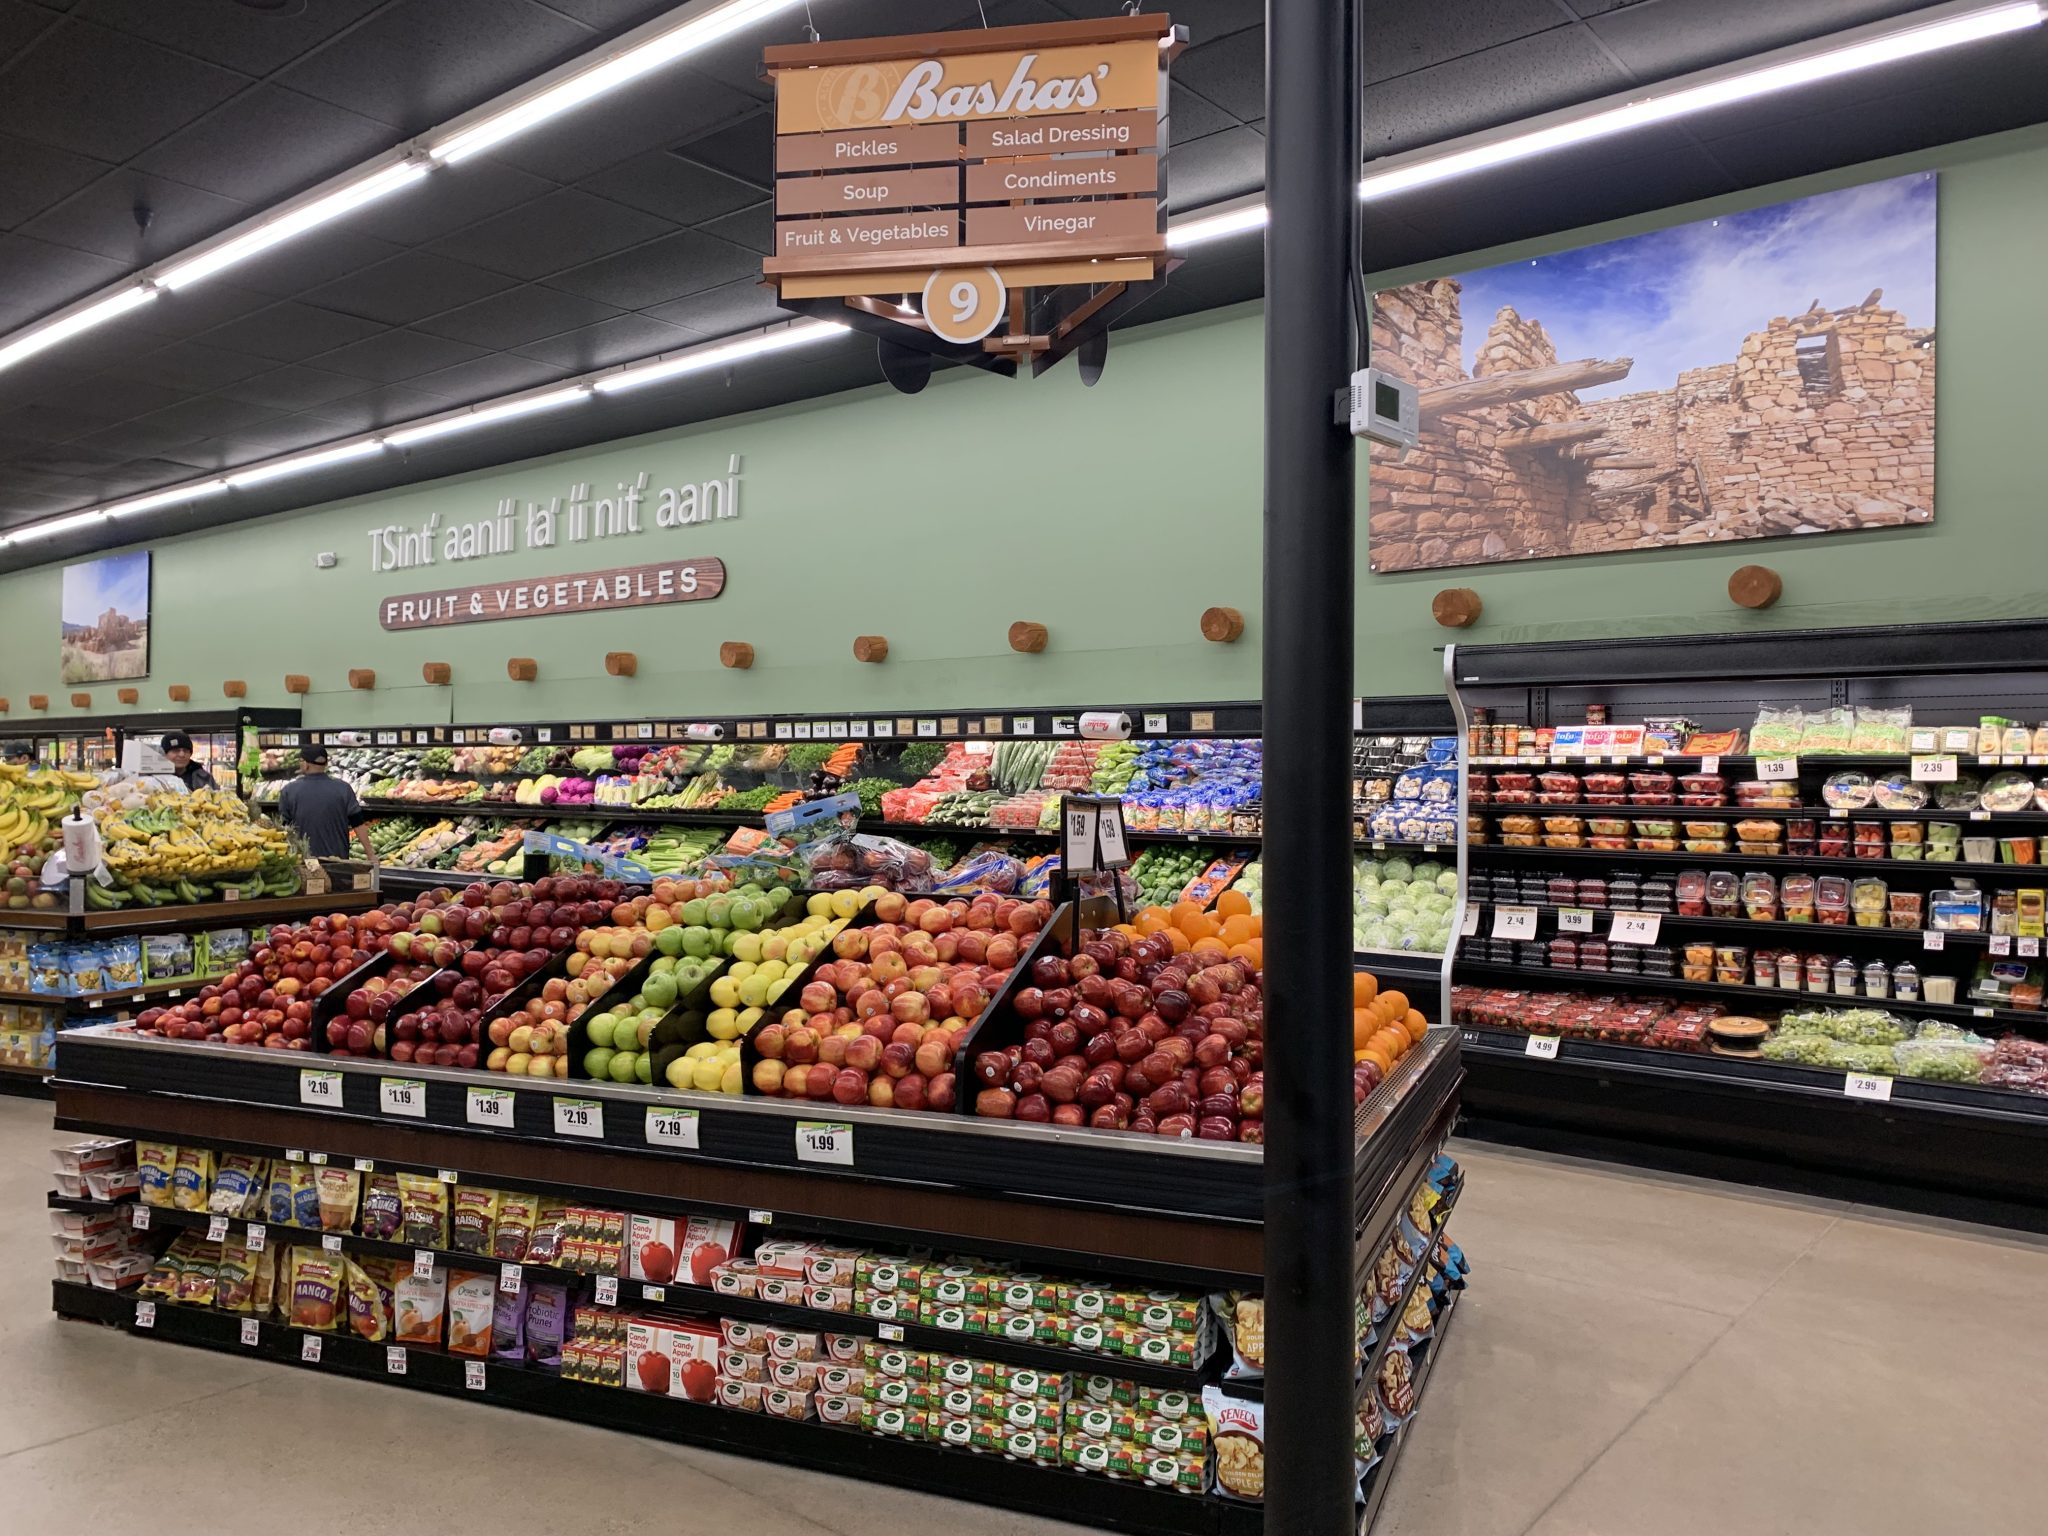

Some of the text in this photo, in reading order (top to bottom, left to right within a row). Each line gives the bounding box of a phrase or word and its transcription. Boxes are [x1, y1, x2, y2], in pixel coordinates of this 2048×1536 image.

[881, 54, 1110, 121] Bashas'
[992, 124, 1130, 148] Salad Dressing
[835, 140, 898, 158] Pickles
[1004, 168, 1117, 190] Condiments
[843, 184, 889, 202] Soup
[1024, 214, 1096, 235] Vinegar
[785, 222, 949, 247] Fruit & Vegetables
[949, 281, 978, 323] 9
[387, 567, 699, 624] FRUIT & VEGETABLES
[1764, 763, 1784, 774] $1.39
[1921, 763, 1943, 773] $2.39
[1564, 915, 1582, 925] $3.99
[1535, 1041, 1553, 1052] $4.99
[308, 1080, 329, 1095] $2.19
[1855, 1080, 1877, 1091] $2.99
[389, 1089, 411, 1104] $1.19
[476, 1099, 499, 1115] $1.39
[564, 1109, 587, 1125] $2.19
[655, 1119, 681, 1136] $2.19
[806, 1134, 834, 1151] $1.99
[366, 1200, 398, 1212] PRUNES
[405, 1212, 434, 1225] RAISINS
[455, 1216, 484, 1229] RAISINS
[632, 1224, 652, 1235] Candy
[689, 1224, 710, 1235] Candy
[632, 1231, 650, 1241] Apple
[686, 1233, 706, 1242] Apple
[632, 1240, 640, 1248] Kit
[685, 1241, 694, 1249] Kit
[632, 1253, 640, 1261] 10
[504, 1281, 518, 1290] 2.59
[296, 1284, 328, 1299] MANGO
[599, 1293, 614, 1302] 2.99
[528, 1315, 552, 1328] Prunes
[629, 1333, 649, 1343] Candy
[629, 1341, 647, 1350] Apple
[672, 1341, 695, 1352] Candy
[629, 1349, 638, 1357] Kit
[672, 1348, 692, 1358] Apple
[672, 1357, 681, 1365] Kit
[672, 1371, 680, 1379] 10
[1219, 1408, 1258, 1427] SENECA
[1225, 1477, 1252, 1488] APPLE
